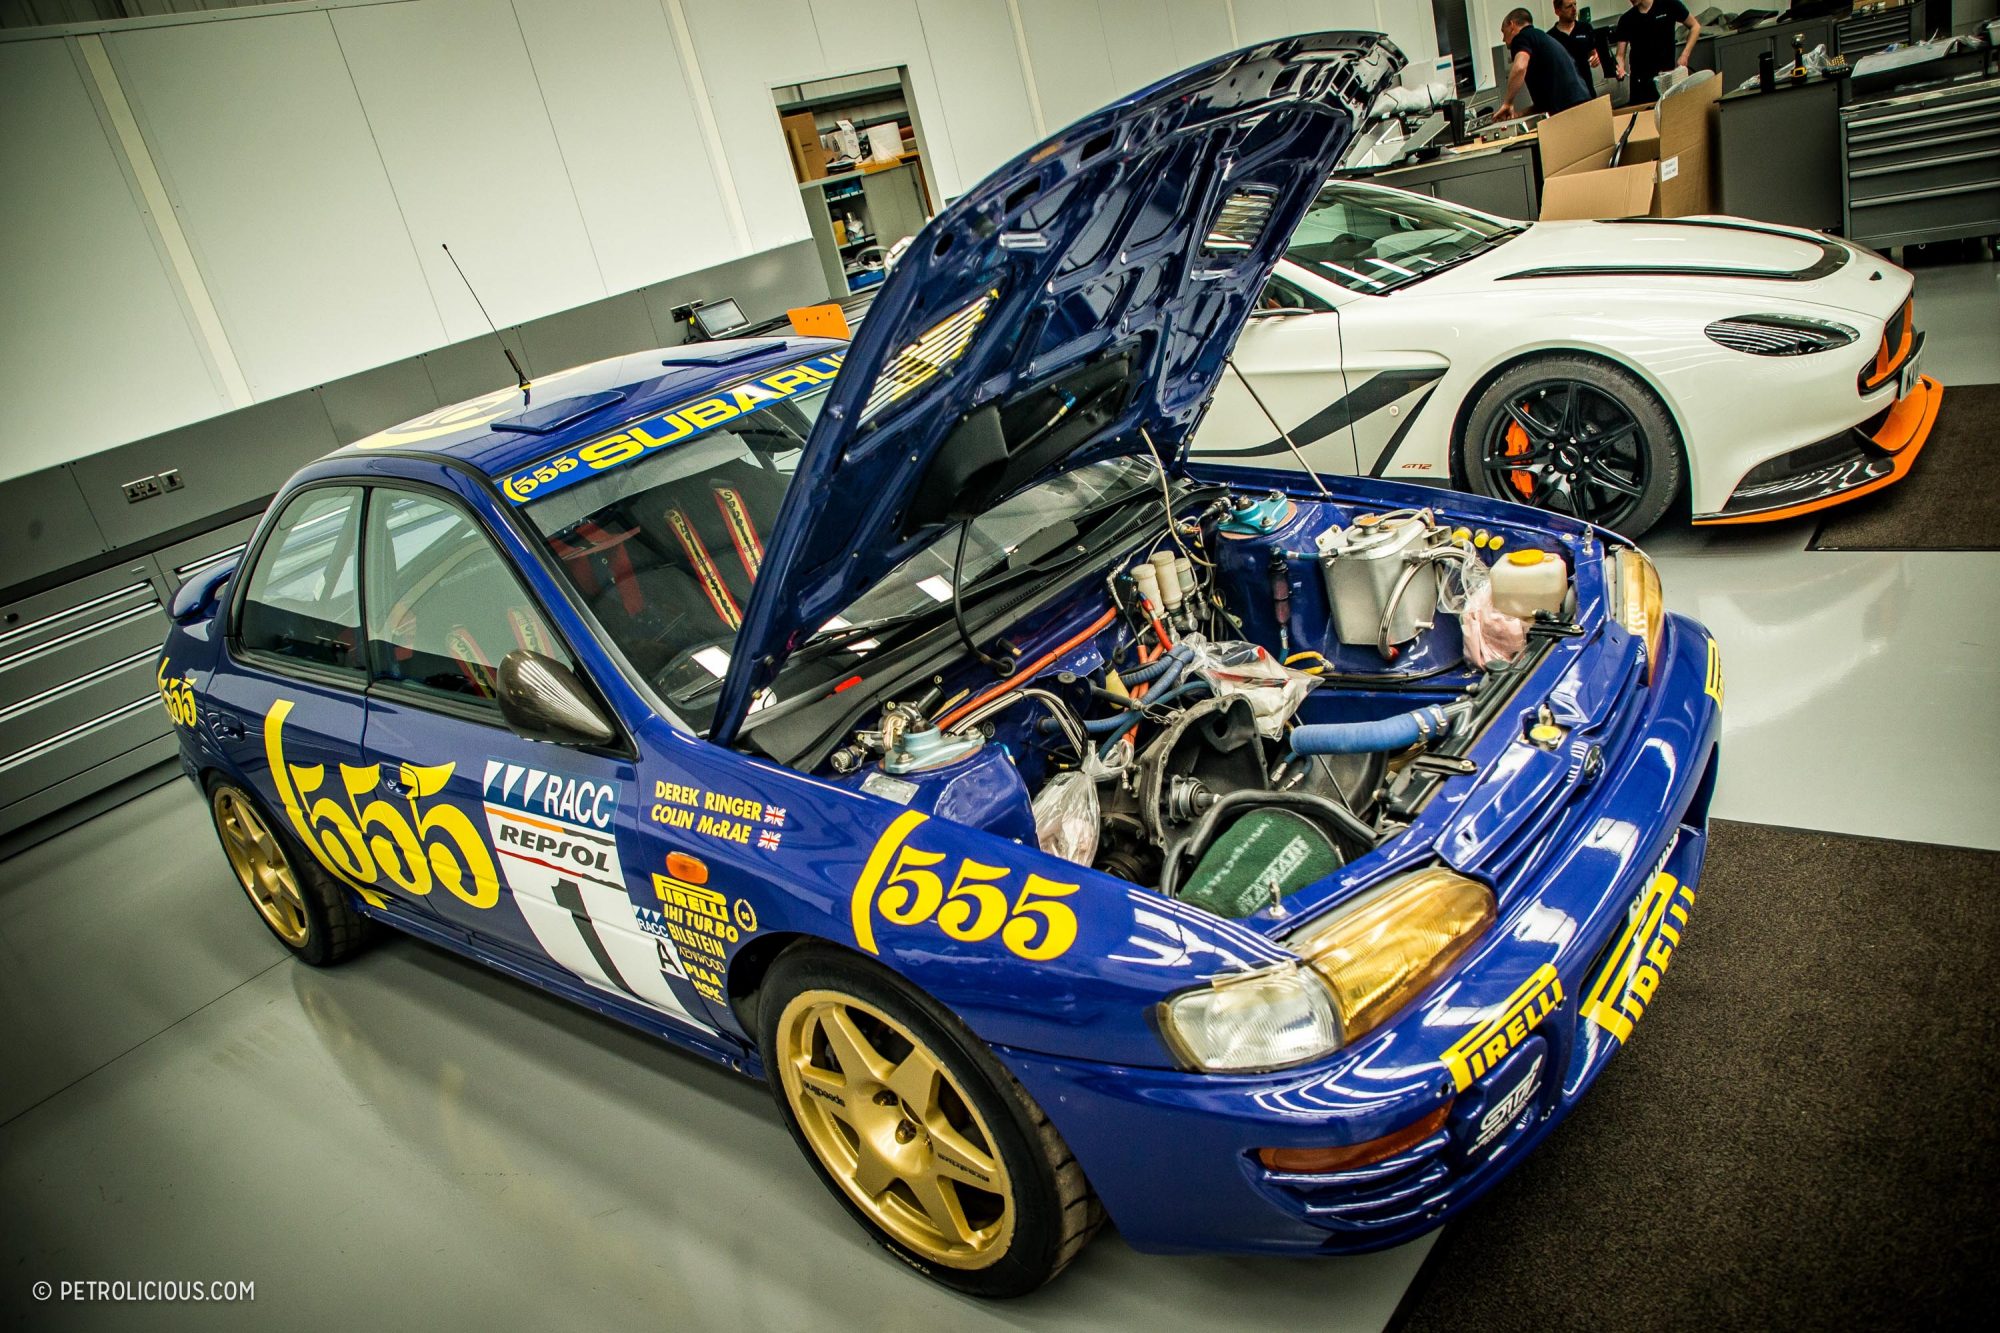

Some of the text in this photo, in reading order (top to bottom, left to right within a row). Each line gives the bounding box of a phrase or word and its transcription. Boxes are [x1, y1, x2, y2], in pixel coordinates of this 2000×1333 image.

[578, 353, 846, 470] SUBARU
[544, 774, 614, 829] RACC
[655, 780, 762, 821] DEREK RINGER
[651, 803, 752, 844] COLIN McRAE
[500, 824, 610, 872] REPSOL
[651, 873, 729, 922] PIRELLI
[637, 918, 668, 937] RACC
[664, 903, 739, 943] IHI TURBO
[667, 922, 726, 959] BILSTEIN
[656, 938, 684, 974] A
[680, 945, 726, 973] KENWOOD
[682, 961, 724, 988] PIAA
[1440, 963, 1564, 1093] PIRELLI
